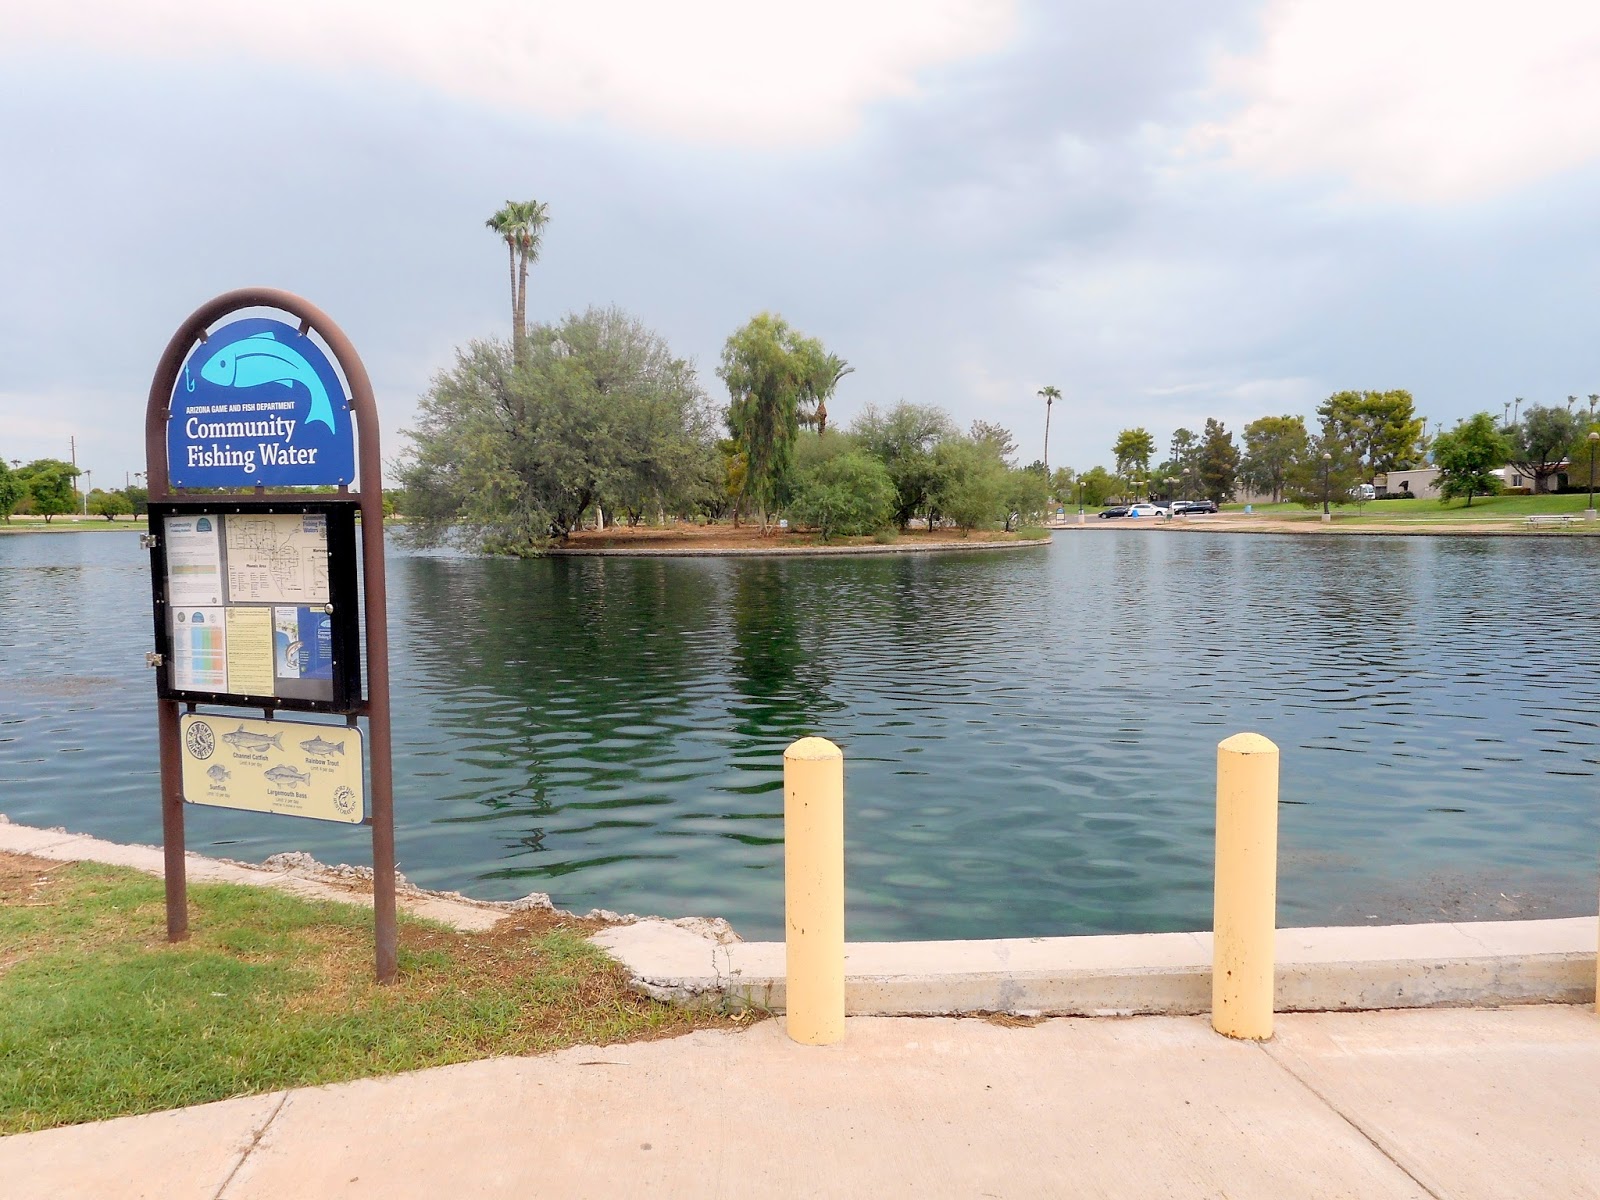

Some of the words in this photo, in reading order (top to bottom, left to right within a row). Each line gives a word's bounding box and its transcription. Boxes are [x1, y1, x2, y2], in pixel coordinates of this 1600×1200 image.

[186, 406, 210, 414] ARIZONA
[211, 404, 228, 413] GAME
[229, 404, 240, 412] AND
[242, 403, 255, 412] FISH
[256, 401, 295, 410] DEPARTMENT
[186, 414, 296, 443] Community
[187, 444, 256, 473] Fishing
[258, 443, 317, 465] Water
[267, 789, 295, 797] Largemouth
